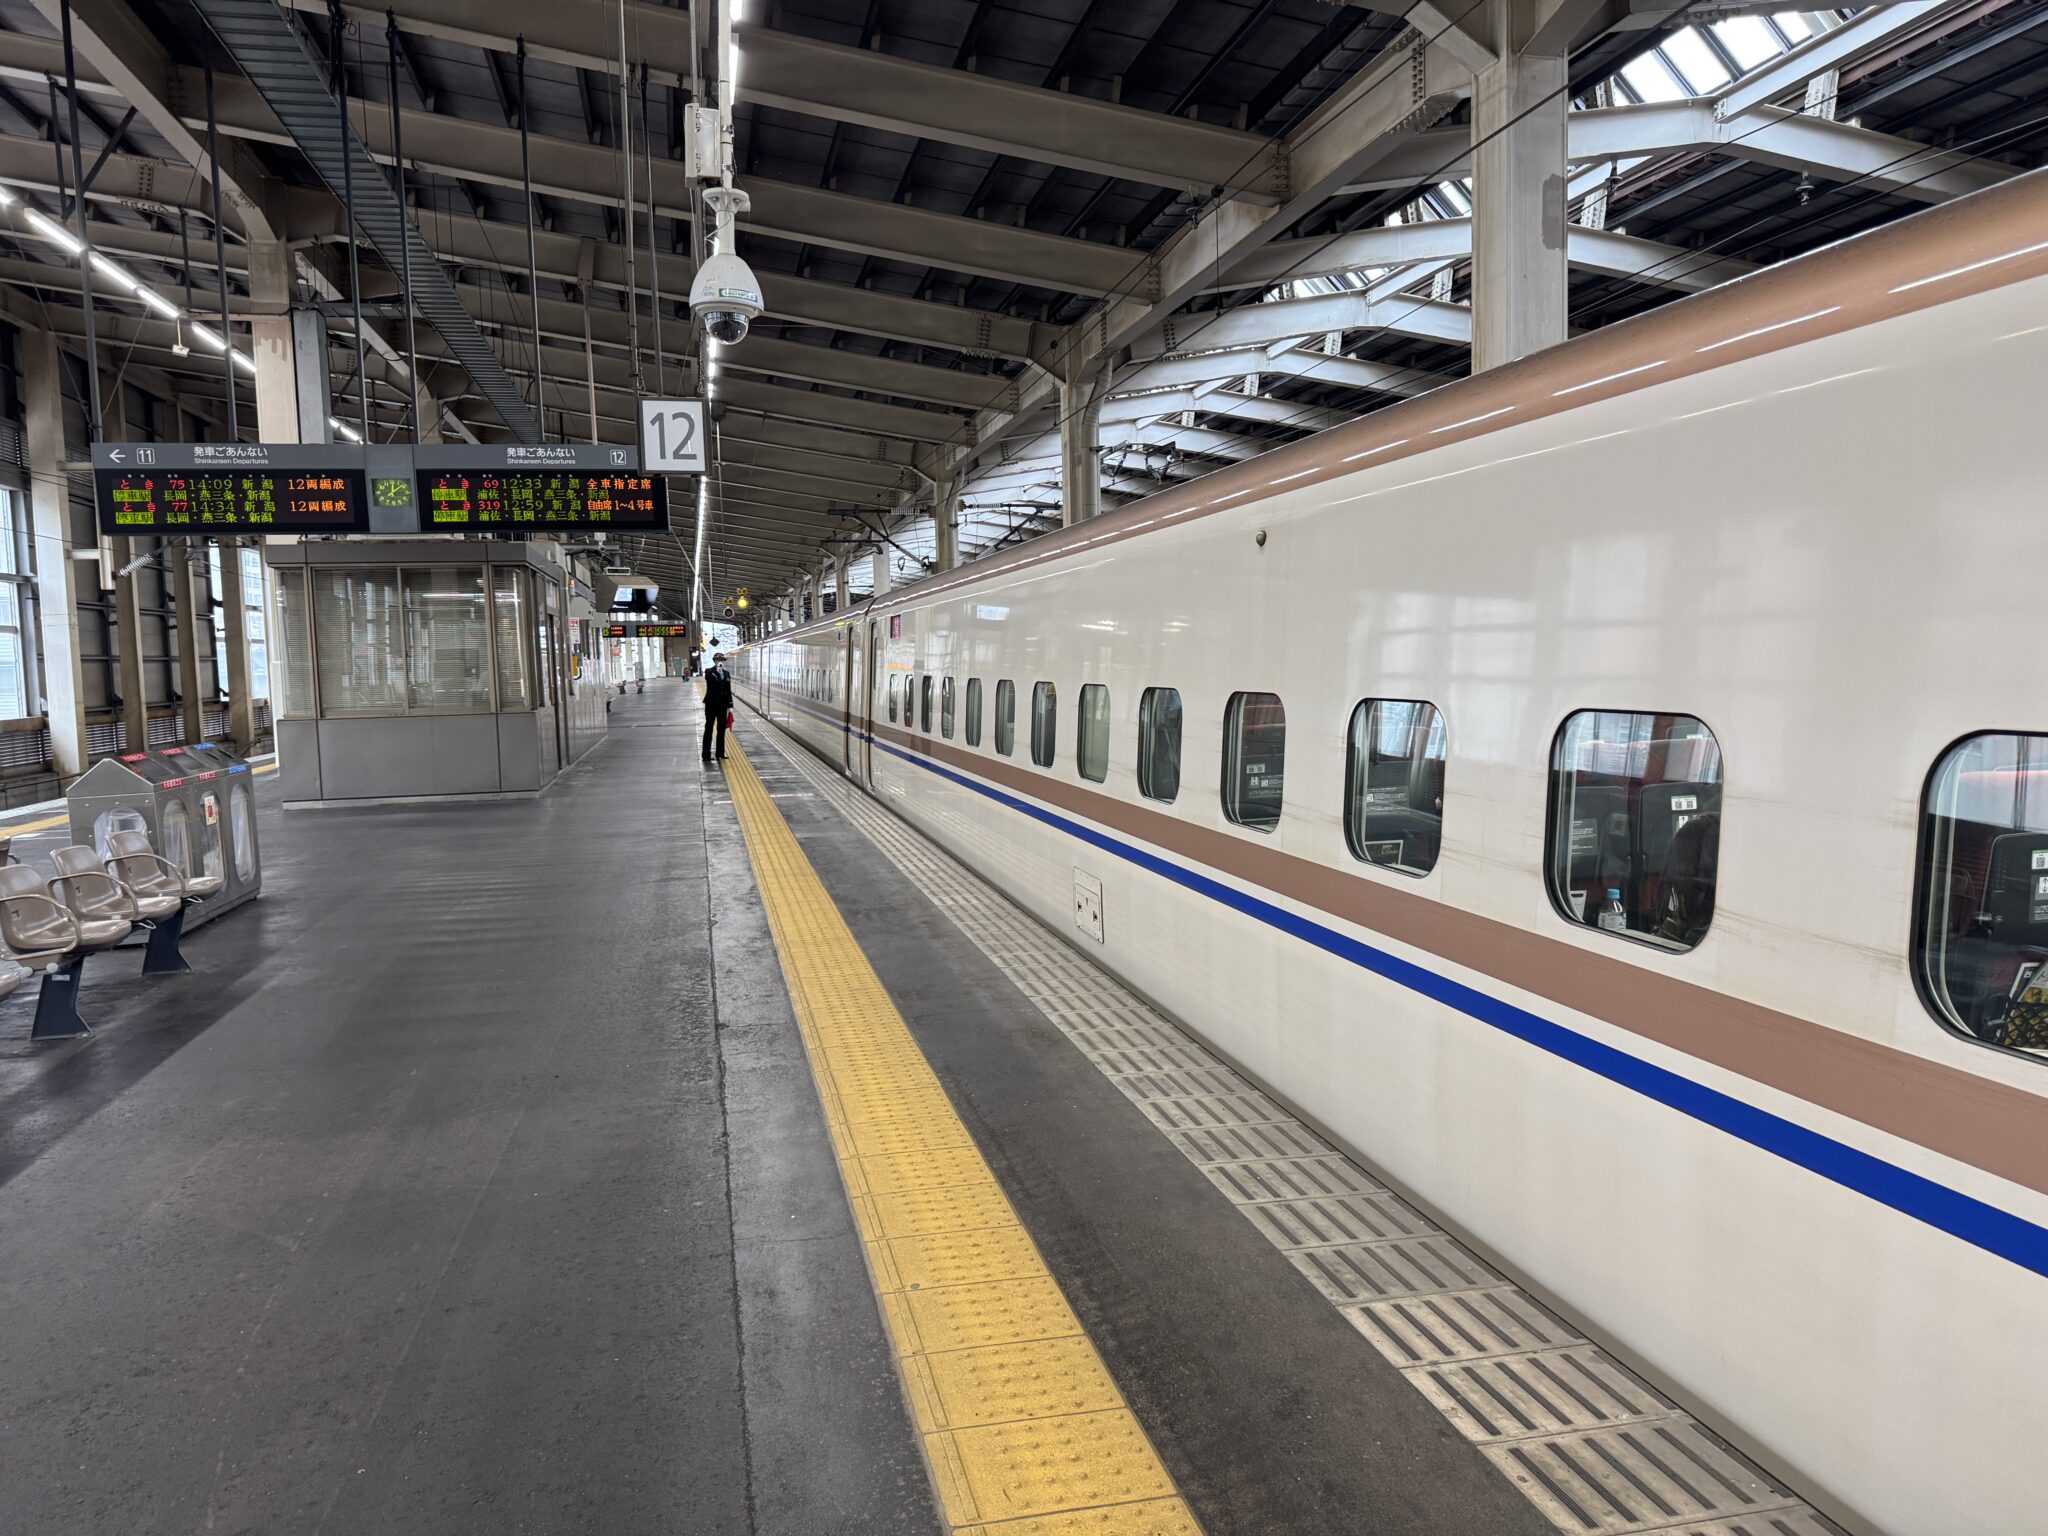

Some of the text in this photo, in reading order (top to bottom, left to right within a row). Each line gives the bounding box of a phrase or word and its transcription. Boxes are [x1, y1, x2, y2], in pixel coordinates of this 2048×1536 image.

[650, 411, 698, 460] 12
[138, 450, 152, 463] 11
[193, 446, 268, 458] 発車ごあんない
[506, 447, 576, 458] 発車ごあんない
[612, 451, 625, 464] 12
[233, 457, 269, 465] Departures
[543, 458, 576, 466] Departures
[169, 480, 185, 490] 75
[189, 479, 233, 490] 14:09
[242, 479, 274, 490] 新潟
[288, 479, 345, 490] 12両編成
[483, 479, 499, 489] 69
[502, 478, 542, 489] 12:33
[550, 478, 580, 489] 新潟
[586, 478, 652, 490] 全車指定席
[172, 502, 188, 512] 77
[192, 501, 236, 512] 14:34
[244, 501, 276, 512] 新潟
[290, 501, 347, 512] 12両編成
[478, 500, 501, 511] 319
[503, 500, 544, 511] 12:59
[552, 499, 581, 511] 新潟
